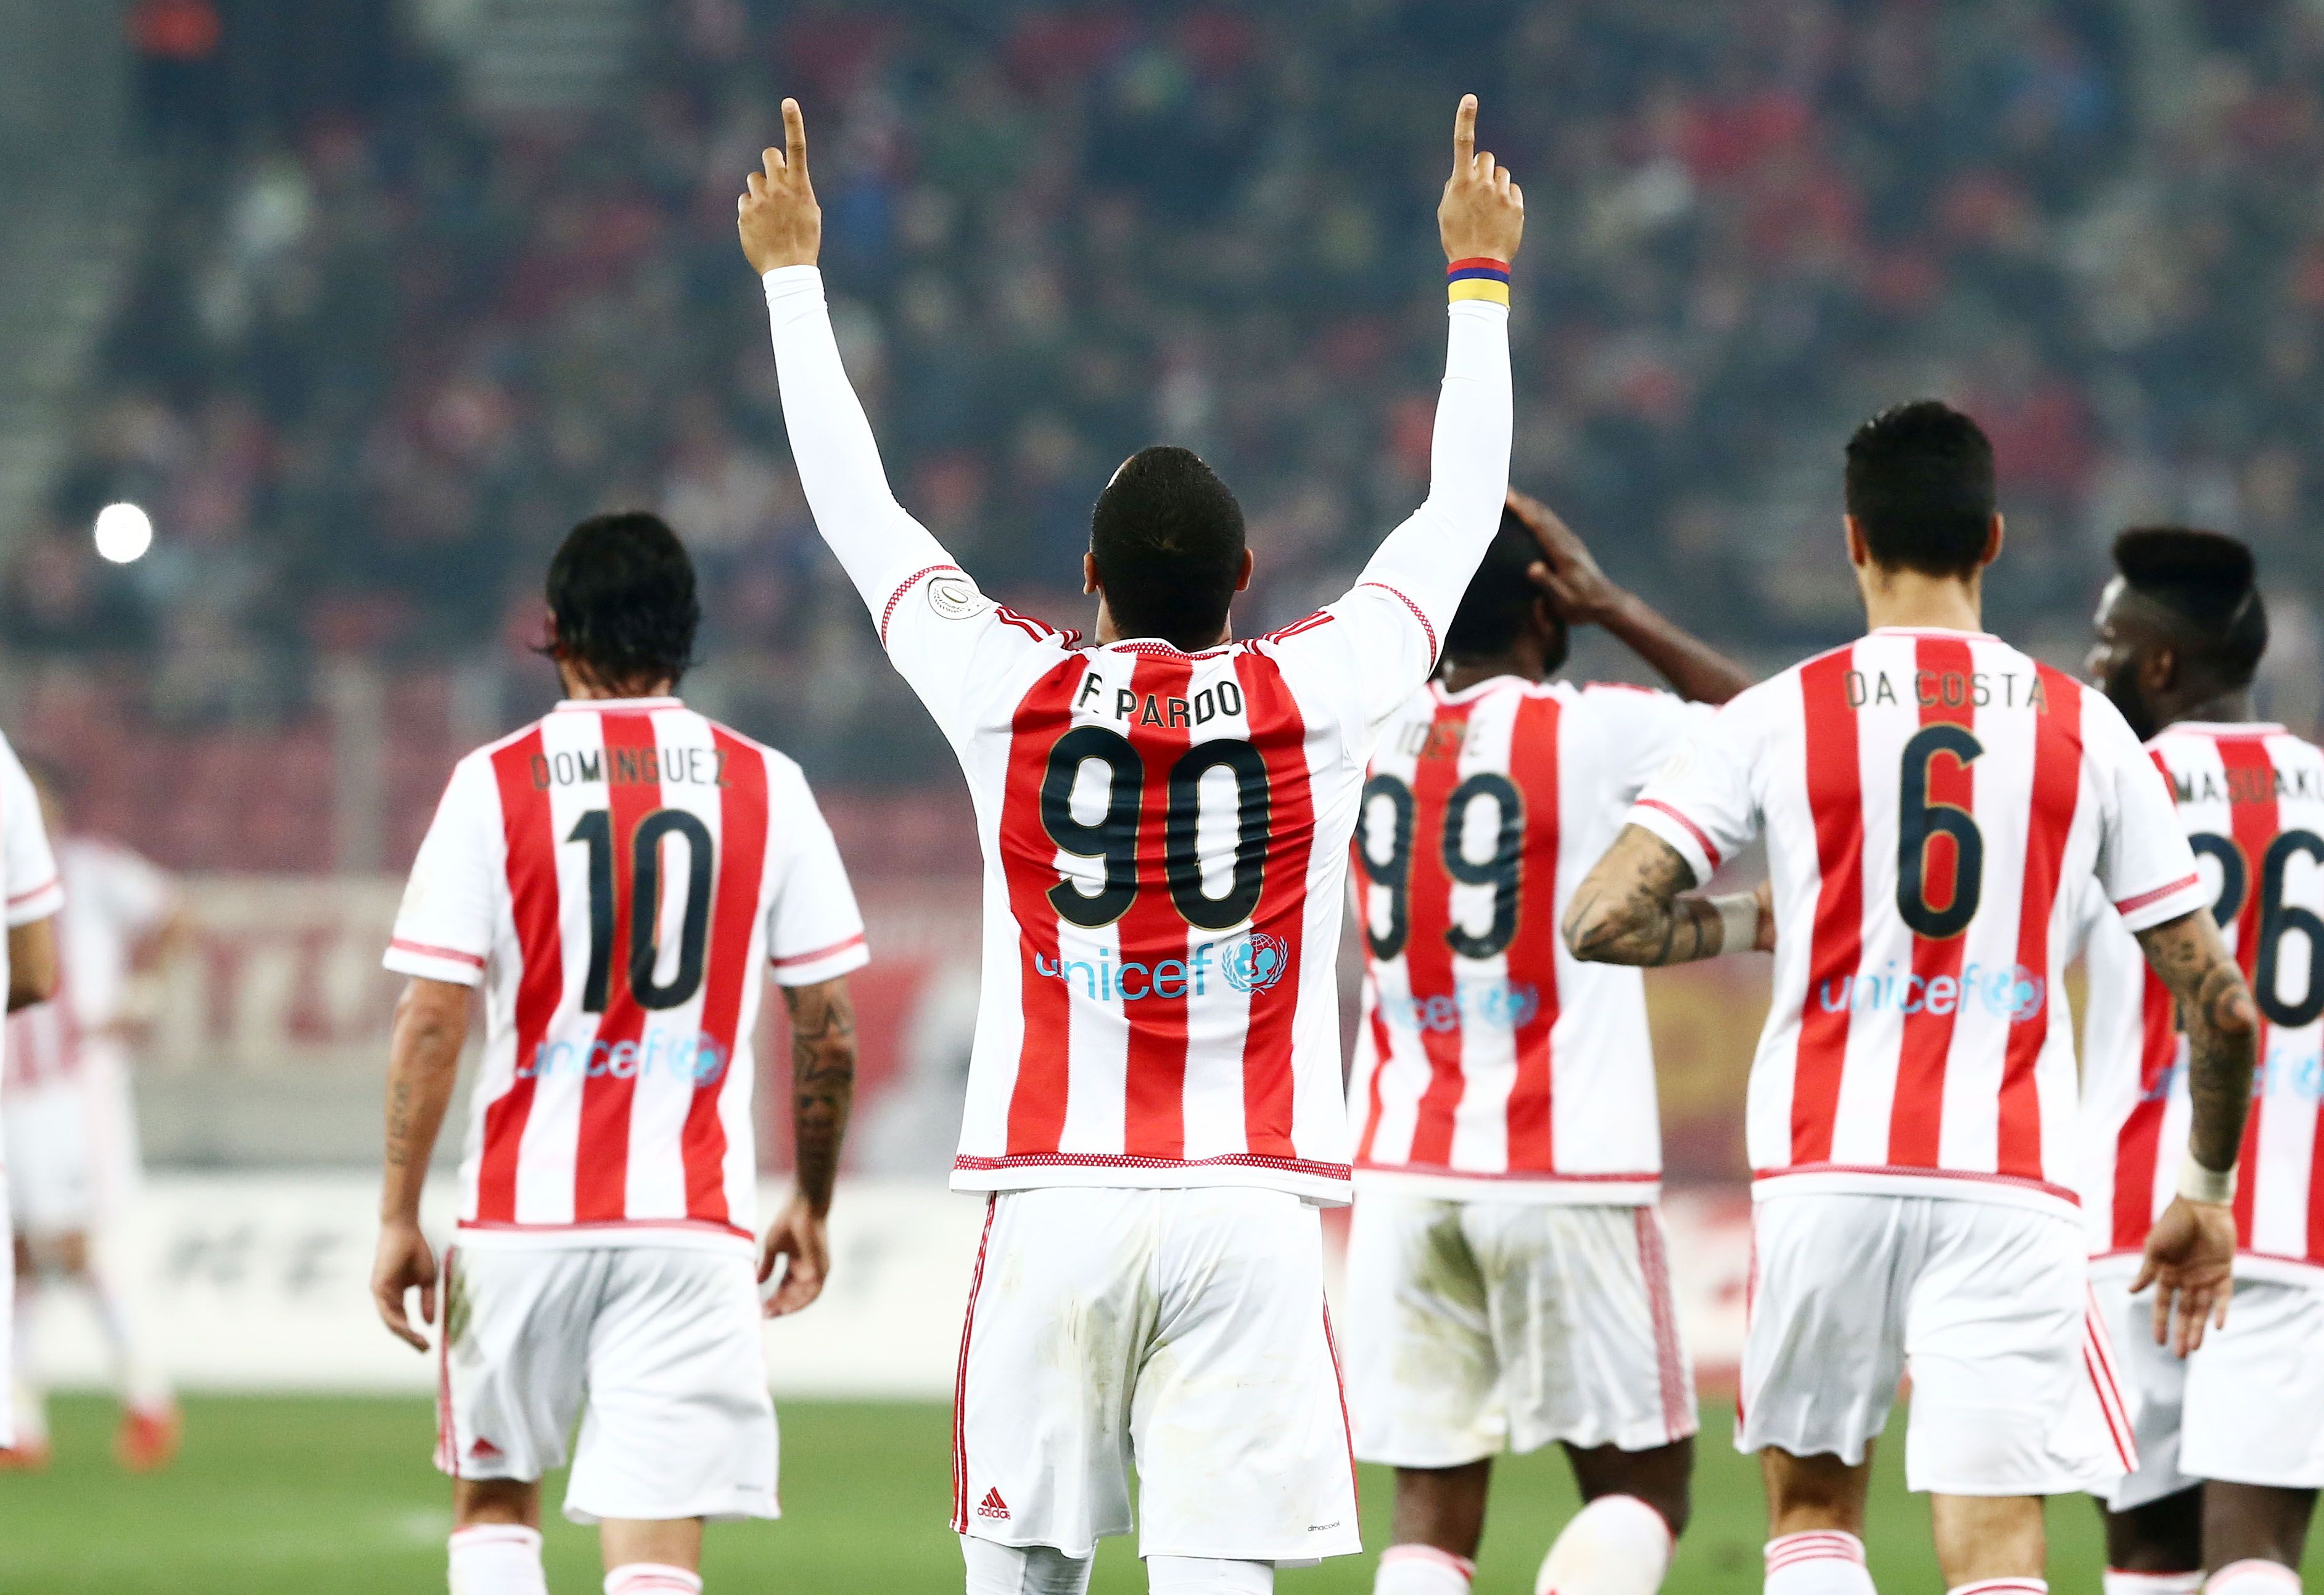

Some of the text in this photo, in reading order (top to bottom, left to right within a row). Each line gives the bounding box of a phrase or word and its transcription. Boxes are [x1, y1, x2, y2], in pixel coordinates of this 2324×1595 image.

[1115, 680, 1242, 728] PARDO
[1845, 670, 2048, 715] DA COSTA
[531, 747, 731, 790] DOMINGUEZ
[1040, 725, 1271, 929] 90
[1896, 722, 1985, 939] 6
[1356, 772, 1527, 961] 99
[566, 809, 714, 1014] 10
[1035, 942, 1213, 1001] unicef
[1820, 960, 1980, 1016] unicef
[517, 1027, 665, 1079] unicef
[978, 1506, 1011, 1520] adidas
